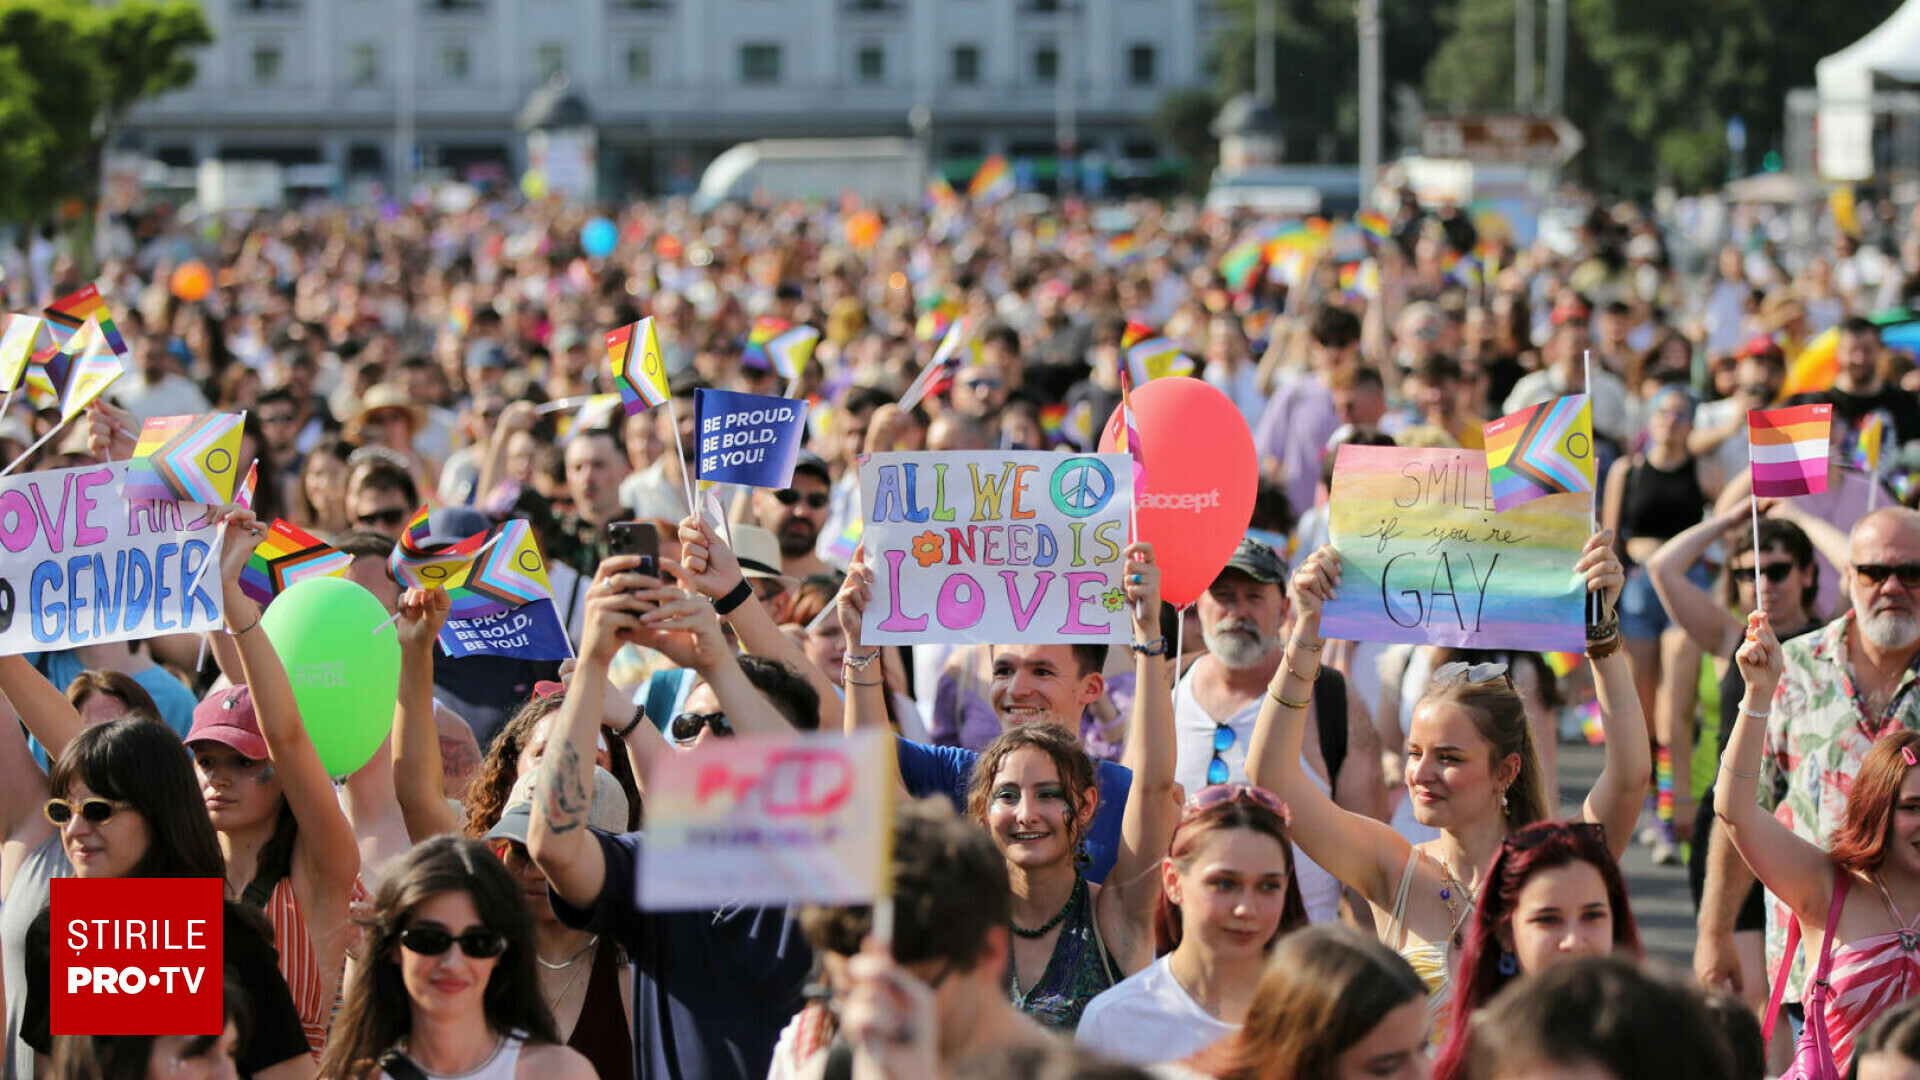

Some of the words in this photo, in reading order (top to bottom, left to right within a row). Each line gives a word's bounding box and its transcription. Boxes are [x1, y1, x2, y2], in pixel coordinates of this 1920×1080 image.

[704, 416, 722, 434] BE
[725, 407, 796, 429] PROUD,
[702, 435, 720, 453] BE
[722, 428, 777, 449] BOLD,
[702, 455, 718, 474] BE
[720, 448, 765, 468] YOU!
[873, 463, 956, 523] ALL
[968, 462, 1040, 522] WE
[1139, 488, 1219, 514] accept
[944, 524, 1059, 567] NEED
[1068, 520, 1121, 567] IS
[1361, 517, 1403, 553] if
[30, 539, 219, 643] GENDER
[876, 550, 1110, 634] LOVE
[1382, 551, 1499, 633] GAY
[447, 619, 471, 630] BE
[455, 630, 479, 640] BE
[479, 613, 532, 639] BOLD,
[463, 640, 488, 651] BE
[487, 633, 529, 648] YOU!
